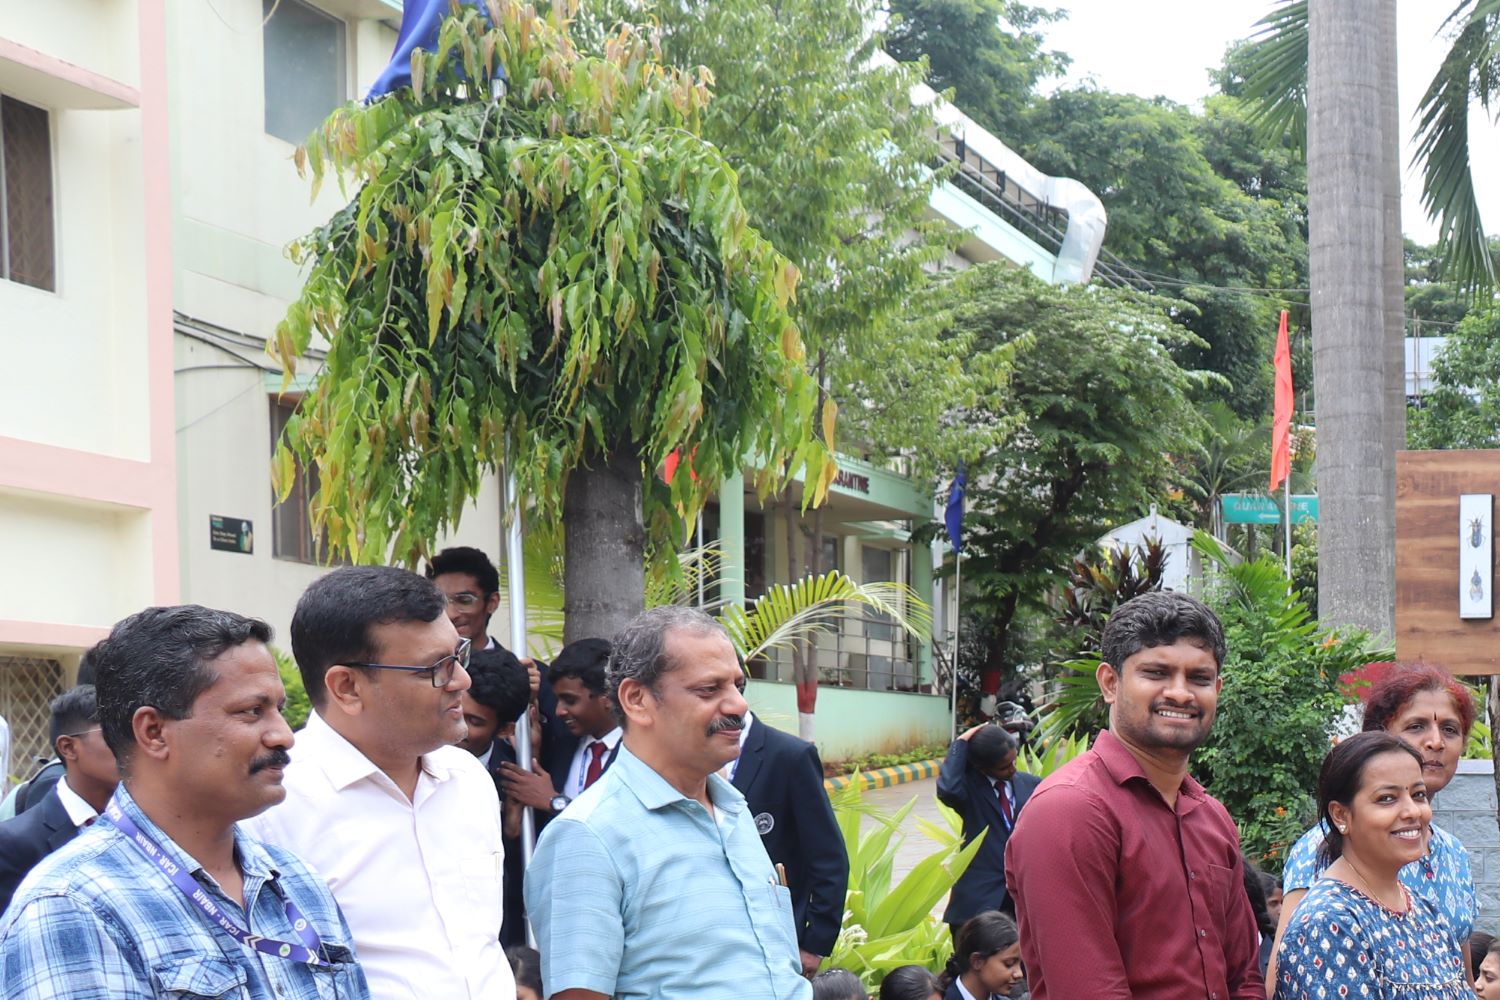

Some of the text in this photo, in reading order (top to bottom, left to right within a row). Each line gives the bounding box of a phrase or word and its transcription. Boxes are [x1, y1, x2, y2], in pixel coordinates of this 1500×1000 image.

[1458, 493, 1494, 619] I
[134, 831, 159, 856] NBAIR
[158, 855, 180, 876] ICAR
[191, 888, 217, 917] NBAIR
[218, 918, 241, 936] ICAR
